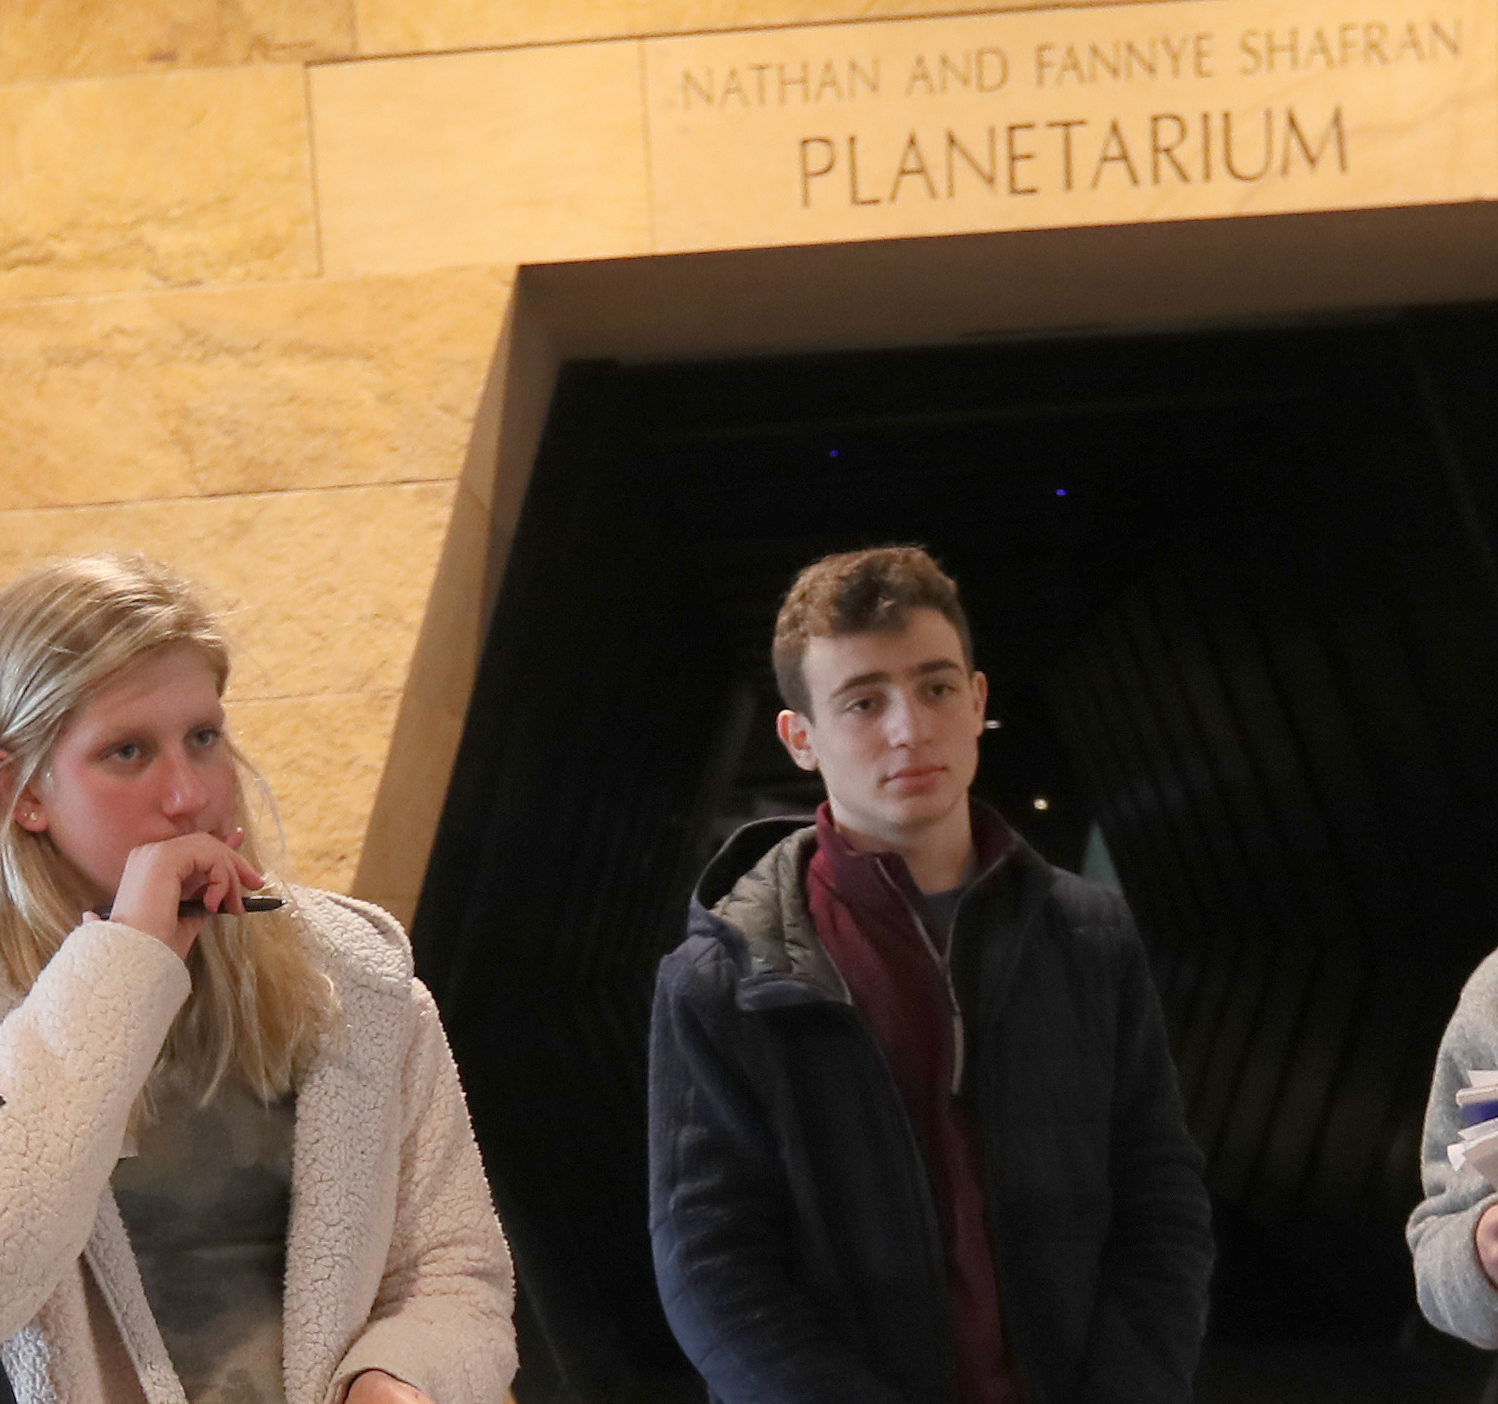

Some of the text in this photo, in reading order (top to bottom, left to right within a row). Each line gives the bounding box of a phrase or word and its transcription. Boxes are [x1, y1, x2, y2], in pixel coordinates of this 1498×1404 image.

[681, 17, 1463, 110] NATHAN AND FANNYE SHAFRAN
[799, 105, 1349, 208] PLANETARIUM
